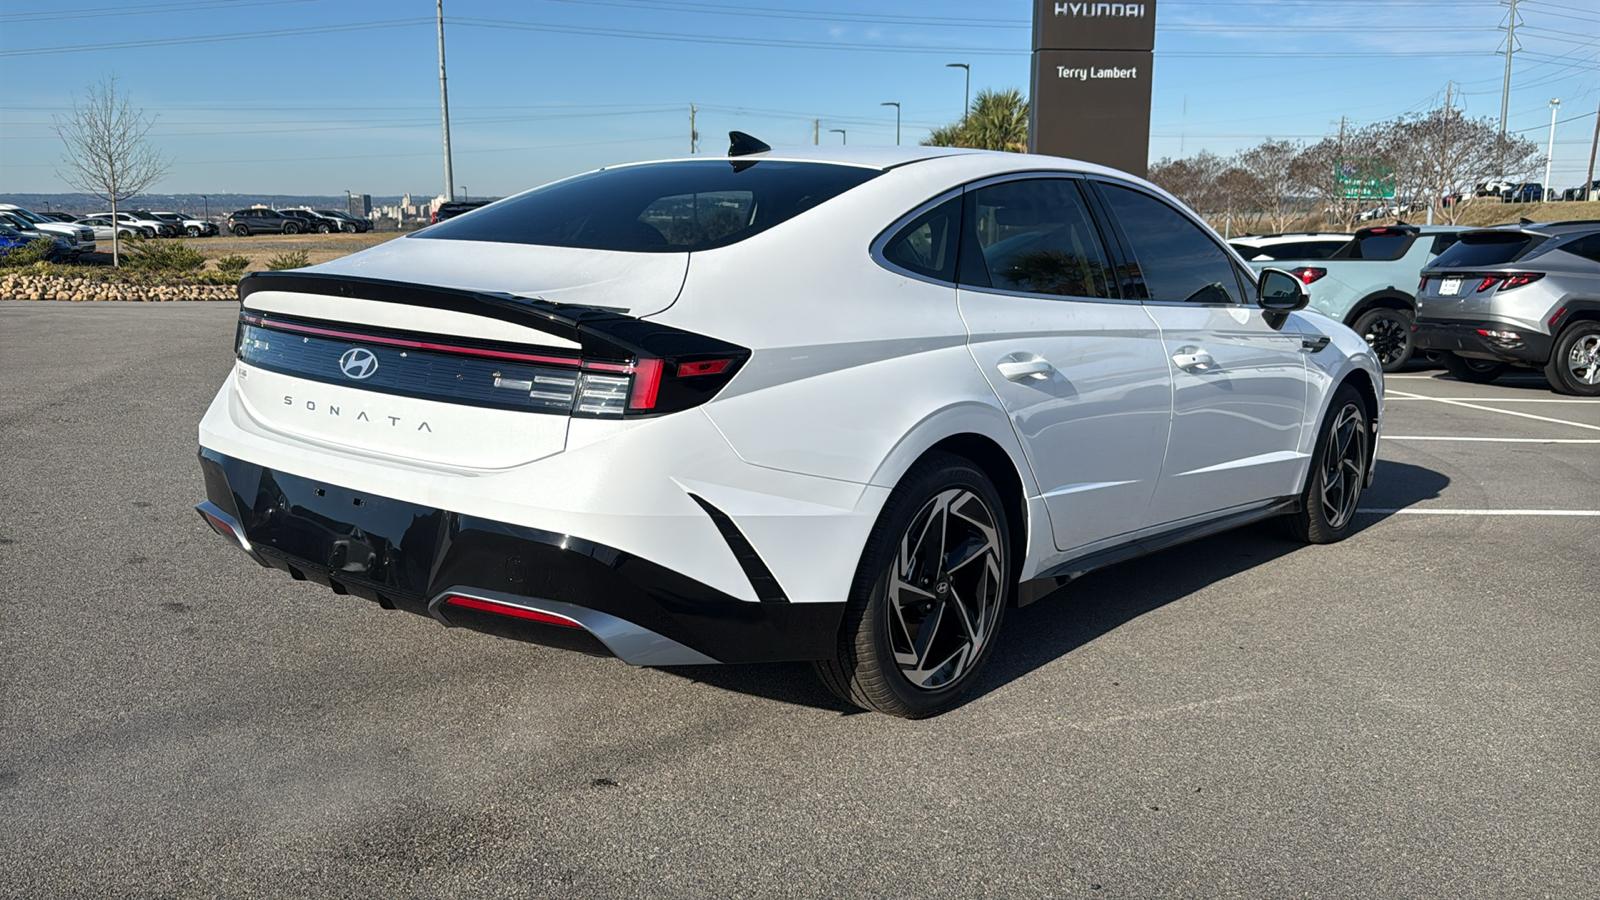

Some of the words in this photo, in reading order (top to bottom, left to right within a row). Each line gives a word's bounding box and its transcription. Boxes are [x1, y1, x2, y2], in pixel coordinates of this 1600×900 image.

[1054, 2, 1145, 18] HYUNDAI
[1056, 66, 1087, 81] Terry
[1090, 66, 1137, 79] Lambert
[283, 395, 432, 433] SONATA
